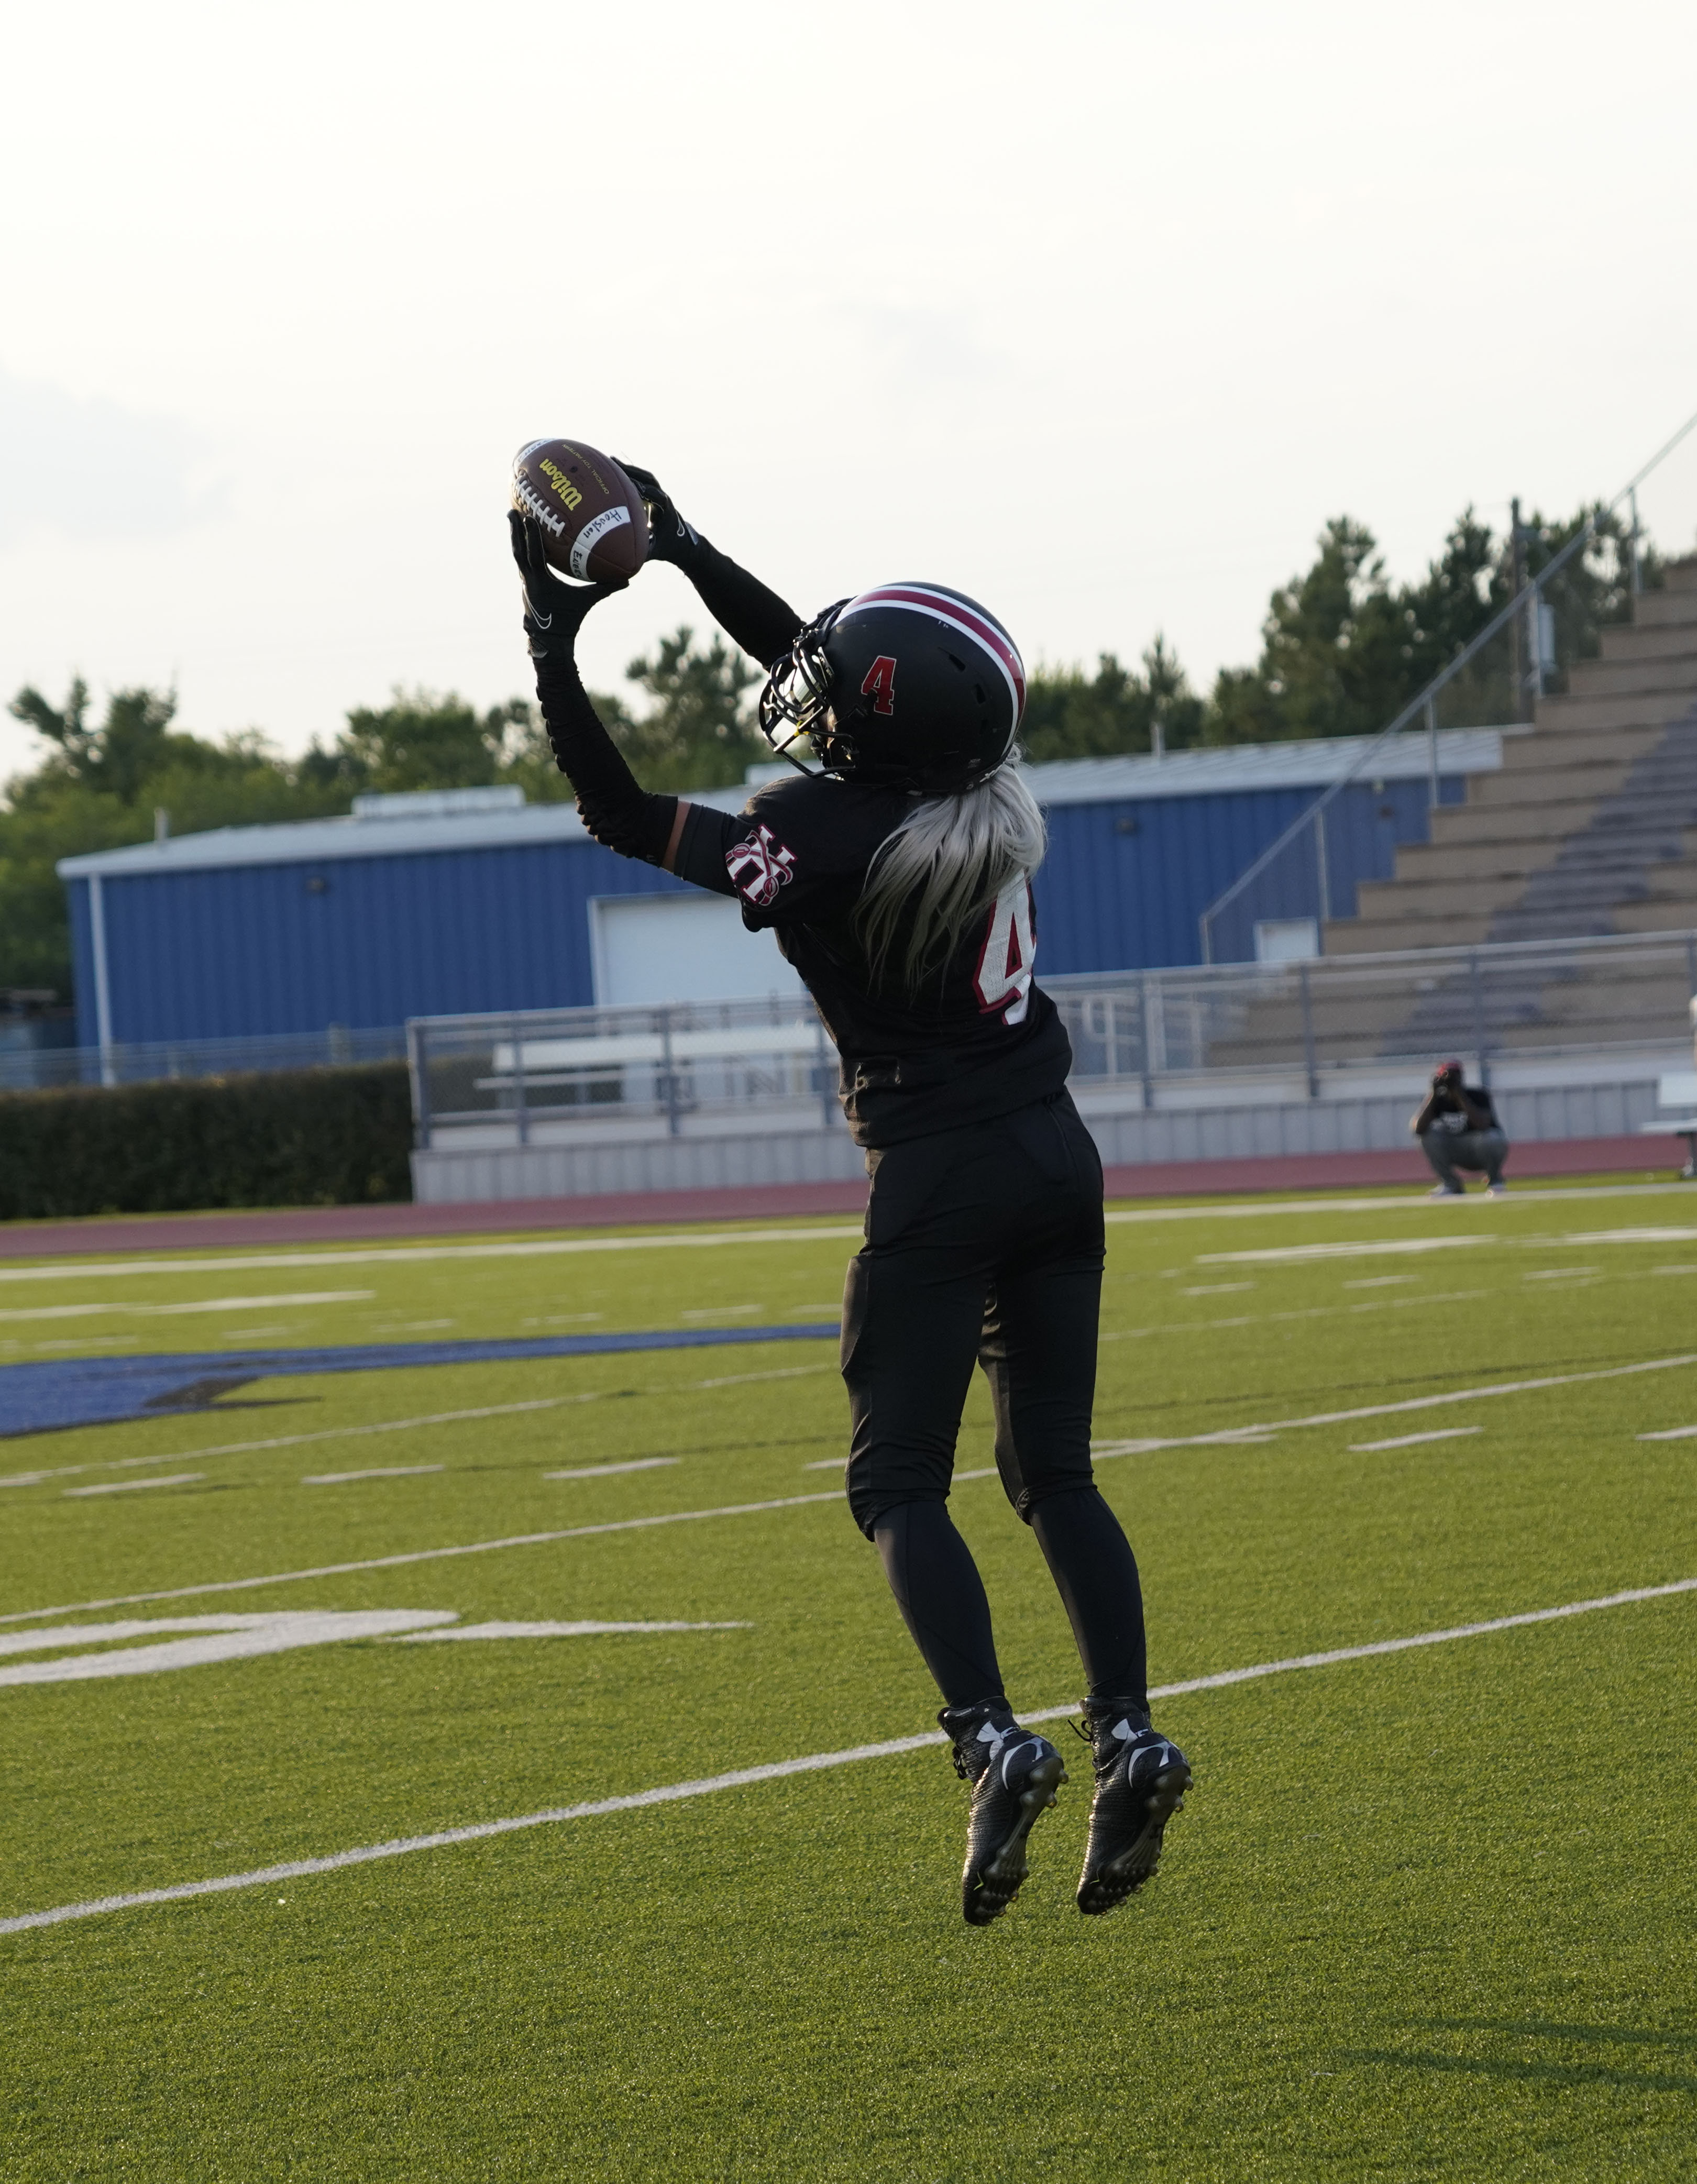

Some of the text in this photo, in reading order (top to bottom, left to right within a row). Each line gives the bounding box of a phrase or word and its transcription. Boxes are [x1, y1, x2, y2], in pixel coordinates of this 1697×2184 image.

[539, 459, 582, 511] Wilson
[591, 469, 610, 494] OFFICIAL
[861, 655, 897, 715] 4
[973, 868, 1037, 1025] 4
